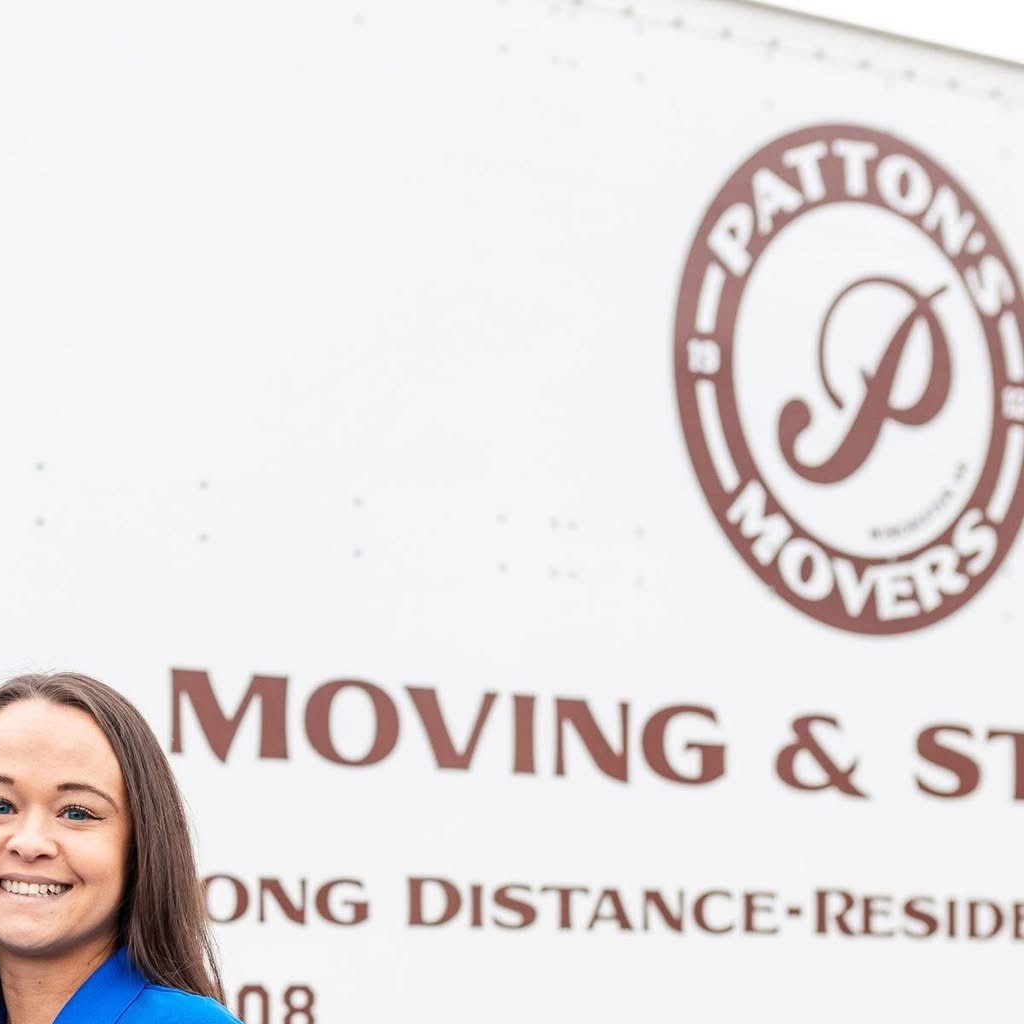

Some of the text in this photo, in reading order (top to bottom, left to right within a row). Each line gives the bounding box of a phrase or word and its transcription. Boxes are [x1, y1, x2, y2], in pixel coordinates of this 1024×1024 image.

[708, 139, 1015, 316] PATTON'S
[778, 273, 950, 484] P
[728, 480, 998, 620] MOVERS
[170, 667, 727, 786] MOVING
[774, 713, 869, 800] &
